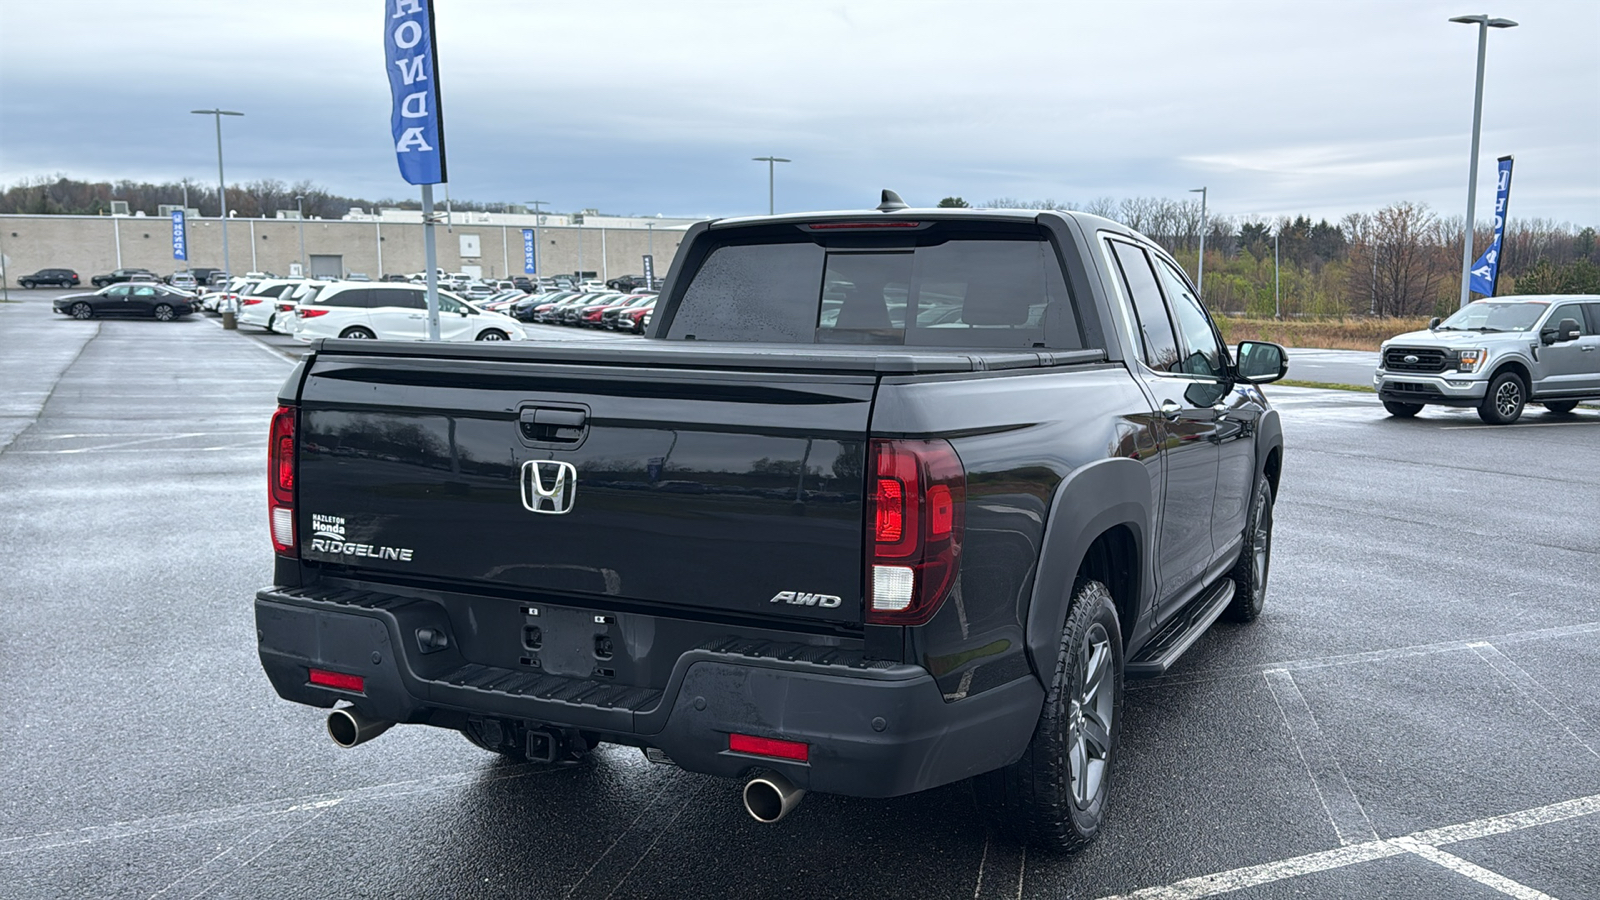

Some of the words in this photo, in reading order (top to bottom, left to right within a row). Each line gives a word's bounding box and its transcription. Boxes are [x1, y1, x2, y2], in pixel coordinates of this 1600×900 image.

[312, 513, 345, 525] HAZLETON
[312, 520, 345, 535] Honda
[311, 539, 414, 562] RIDGELINE
[770, 590, 842, 608] AWD
